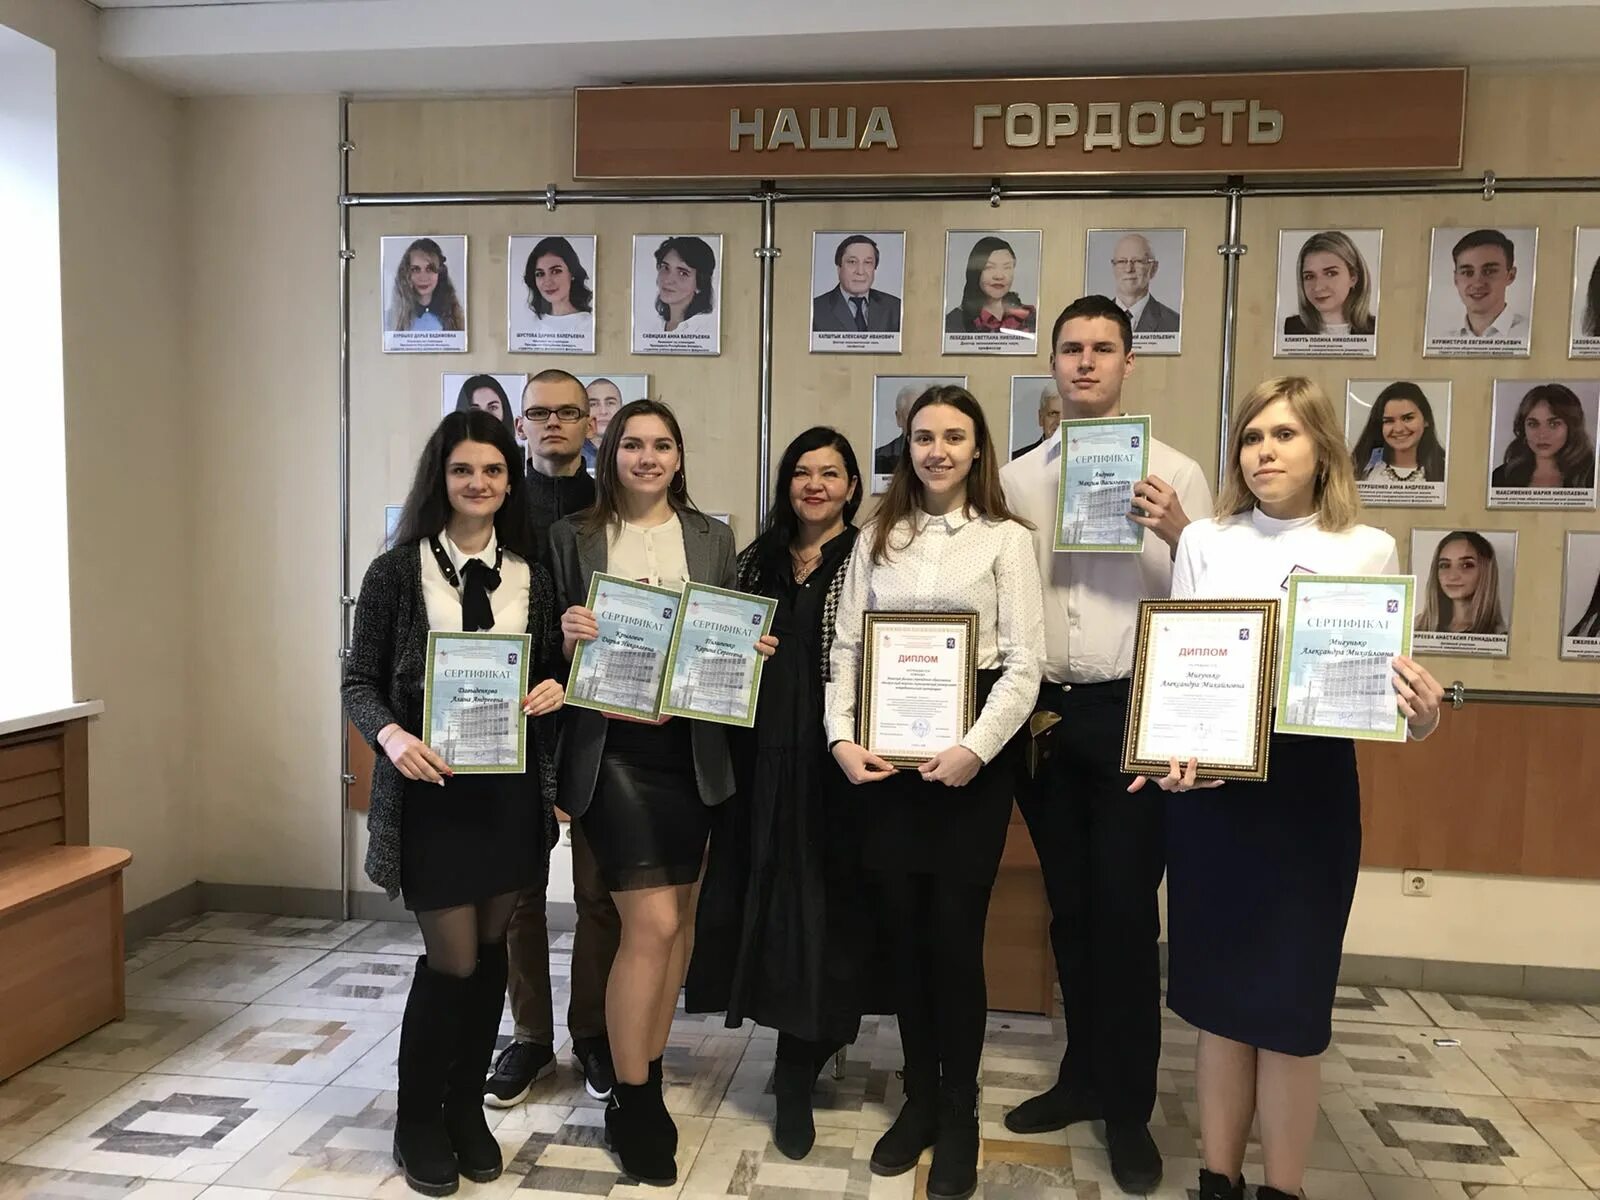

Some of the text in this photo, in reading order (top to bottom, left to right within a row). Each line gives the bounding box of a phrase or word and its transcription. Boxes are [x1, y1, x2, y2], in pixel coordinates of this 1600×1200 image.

[729, 100, 1285, 153] НАША ГОРДОСТЬ
[1076, 454, 1135, 464] СЕРТИФИКАТ
[602, 610, 664, 631] СЕРТИФИКАТ
[1307, 618, 1391, 629] СЕРТИФИКАТ
[693, 619, 752, 637] СЕРТИФИКАТ
[1178, 648, 1228, 657] ДИПЛОМ
[1300, 648, 1345, 657] Александра
[898, 654, 938, 663] ДИПЛОМ
[444, 669, 512, 679] СЕРТИФИКАТ
[1160, 680, 1200, 689] Александра
